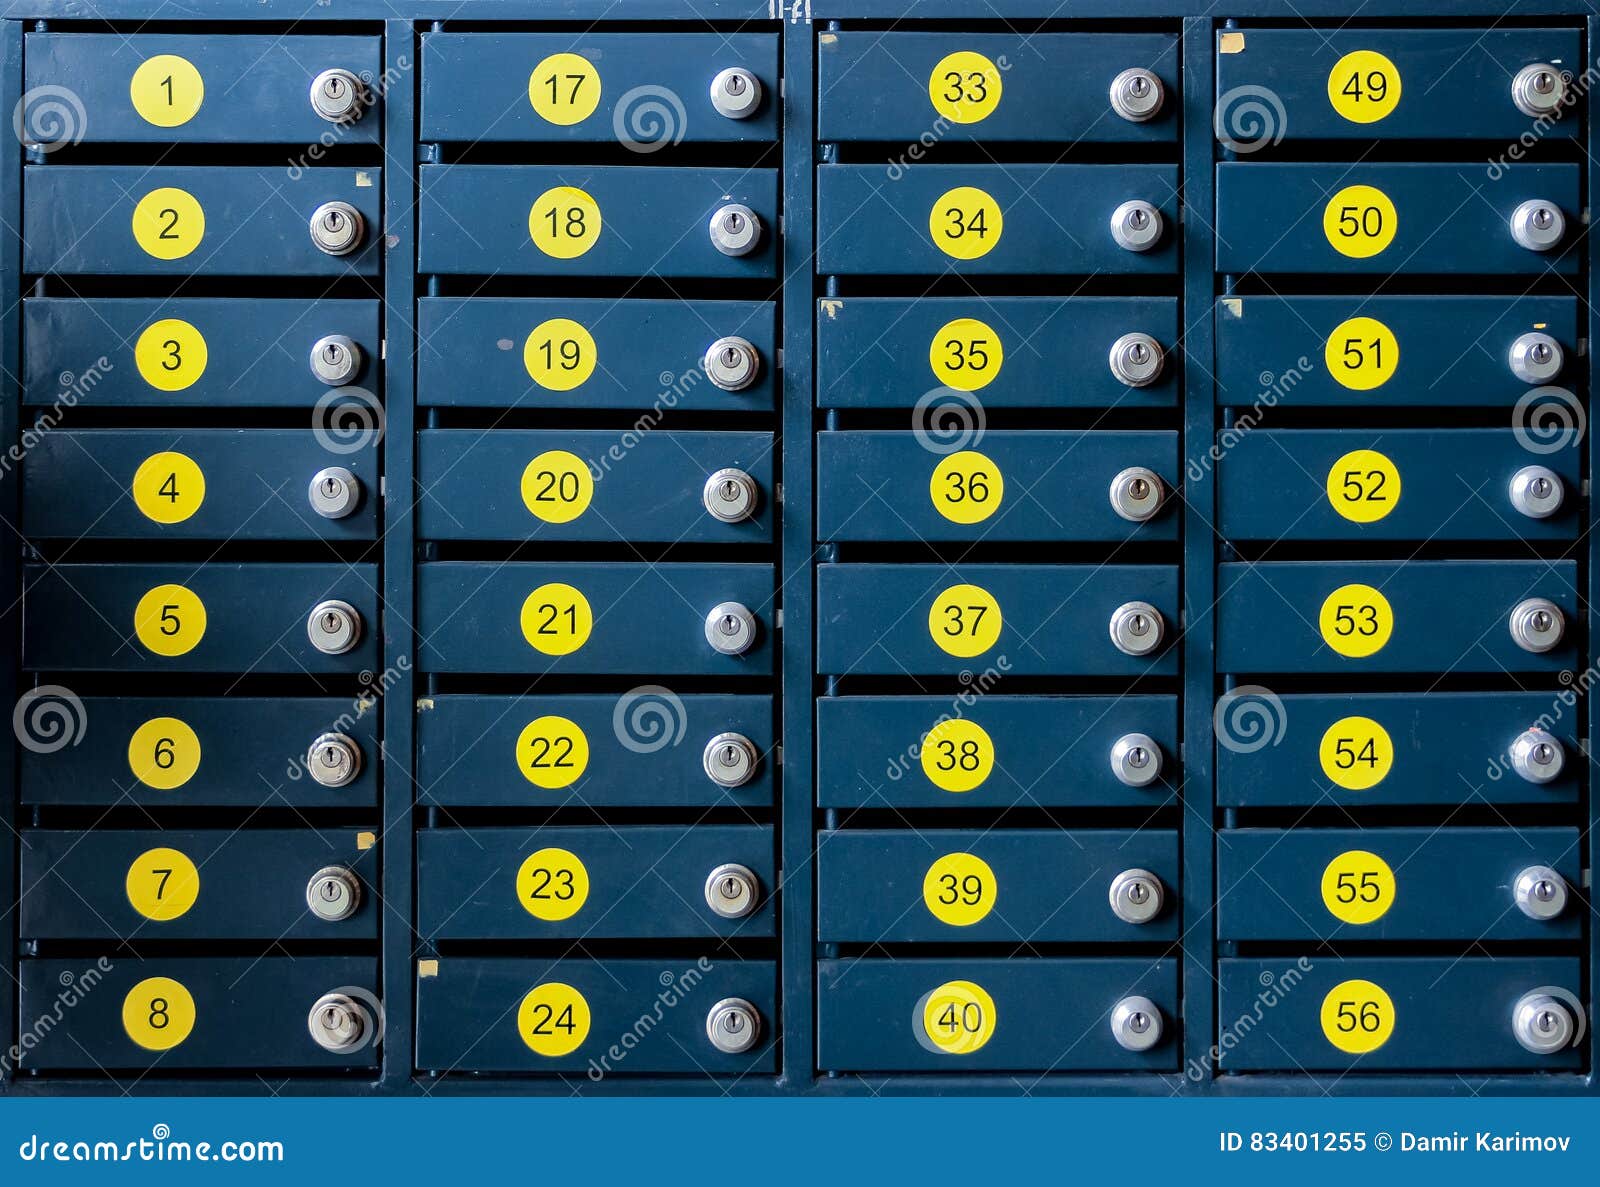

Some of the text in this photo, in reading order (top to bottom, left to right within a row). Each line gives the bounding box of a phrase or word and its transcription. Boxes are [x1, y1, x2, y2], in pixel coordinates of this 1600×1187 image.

[160, 76, 174, 105] 1
[546, 75, 585, 104] 17
[944, 72, 987, 102] 33
[1342, 71, 1387, 102] 49
[159, 209, 179, 239] 2
[546, 208, 586, 238] 18
[945, 208, 988, 238] 34
[1339, 207, 1383, 237] 50
[162, 340, 182, 370] 3
[540, 340, 580, 370] 19
[945, 340, 988, 370] 35
[1343, 338, 1383, 369] 51
[159, 473, 180, 503] 4
[536, 472, 579, 502] 20
[945, 472, 988, 502] 36
[1343, 471, 1387, 501] 52
[160, 605, 181, 635] 5
[538, 604, 577, 634] 21
[944, 606, 988, 636] 37
[1335, 605, 1379, 635] 53
[155, 738, 175, 769] 6
[531, 737, 574, 767] 22
[937, 740, 980, 771] 38
[1335, 738, 1379, 768] 54
[152, 869, 173, 900] 7
[531, 869, 574, 900] 23
[938, 874, 982, 905] 39
[1337, 872, 1380, 903] 55
[149, 998, 170, 1029] 8
[533, 1004, 576, 1034] 24
[938, 1002, 982, 1033] 40
[1337, 1002, 1380, 1033] 56
